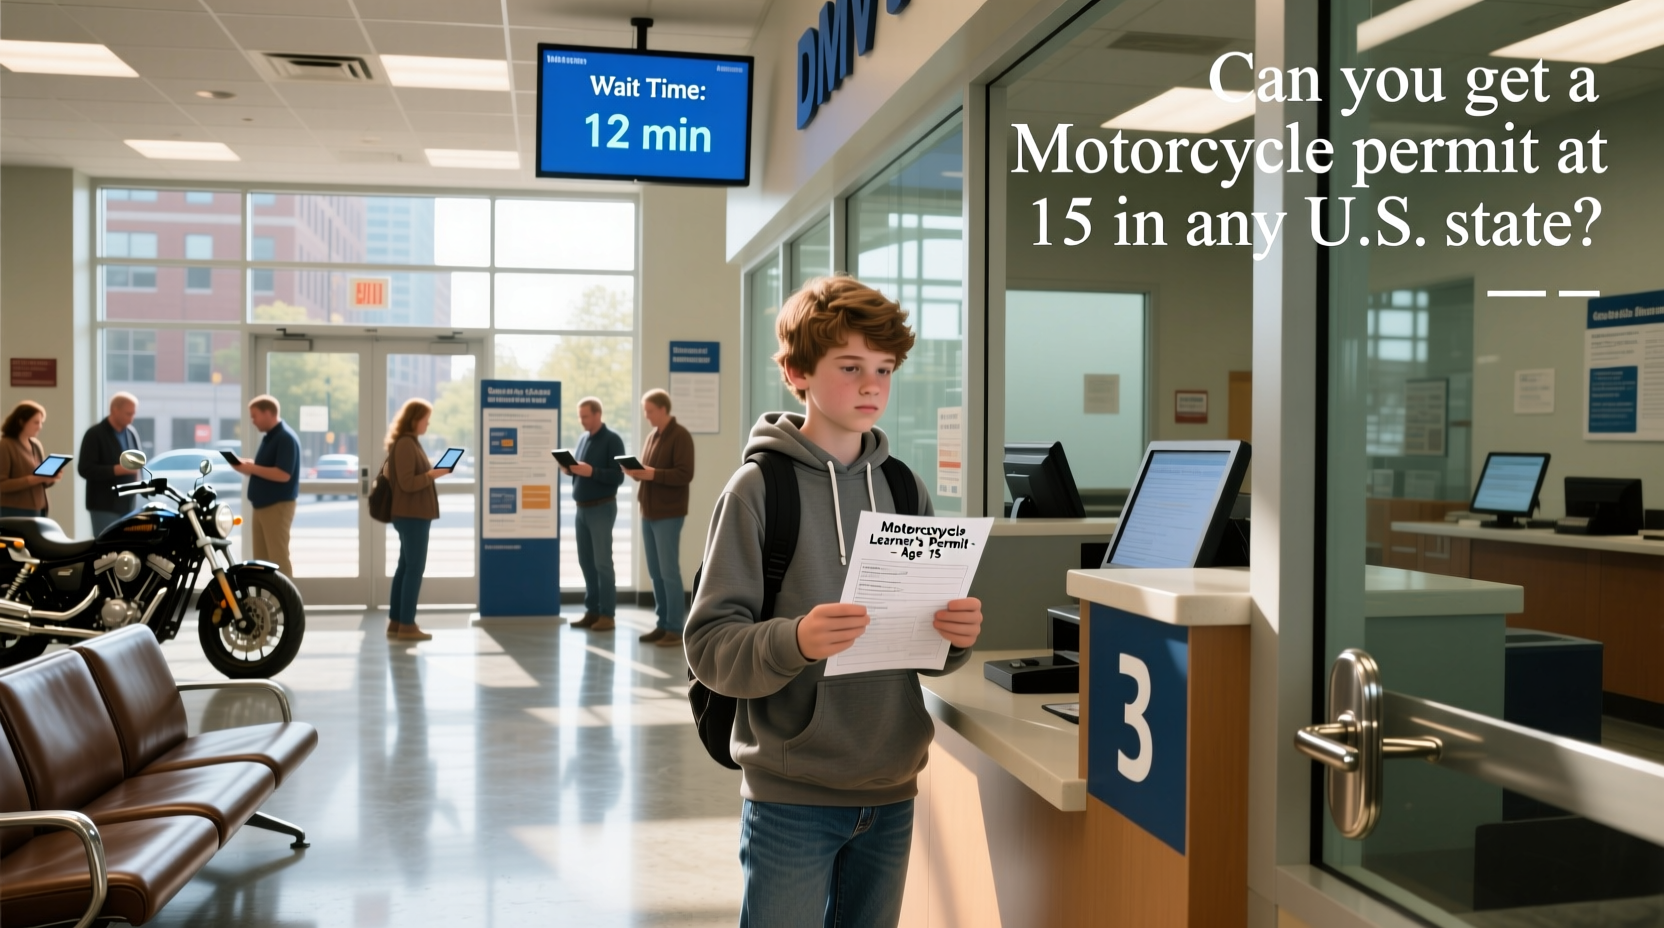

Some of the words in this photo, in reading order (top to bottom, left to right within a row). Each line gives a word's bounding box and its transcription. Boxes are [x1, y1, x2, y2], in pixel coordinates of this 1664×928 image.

[797, 0, 879, 130] DMV
[590, 75, 641, 98] Wait
[645, 77, 706, 101] Time:
[585, 113, 630, 149] 12
[642, 116, 711, 153] min
[901, 547, 923, 561] Age
[929, 537, 969, 549] Permit
[1117, 652, 1153, 783] 3
